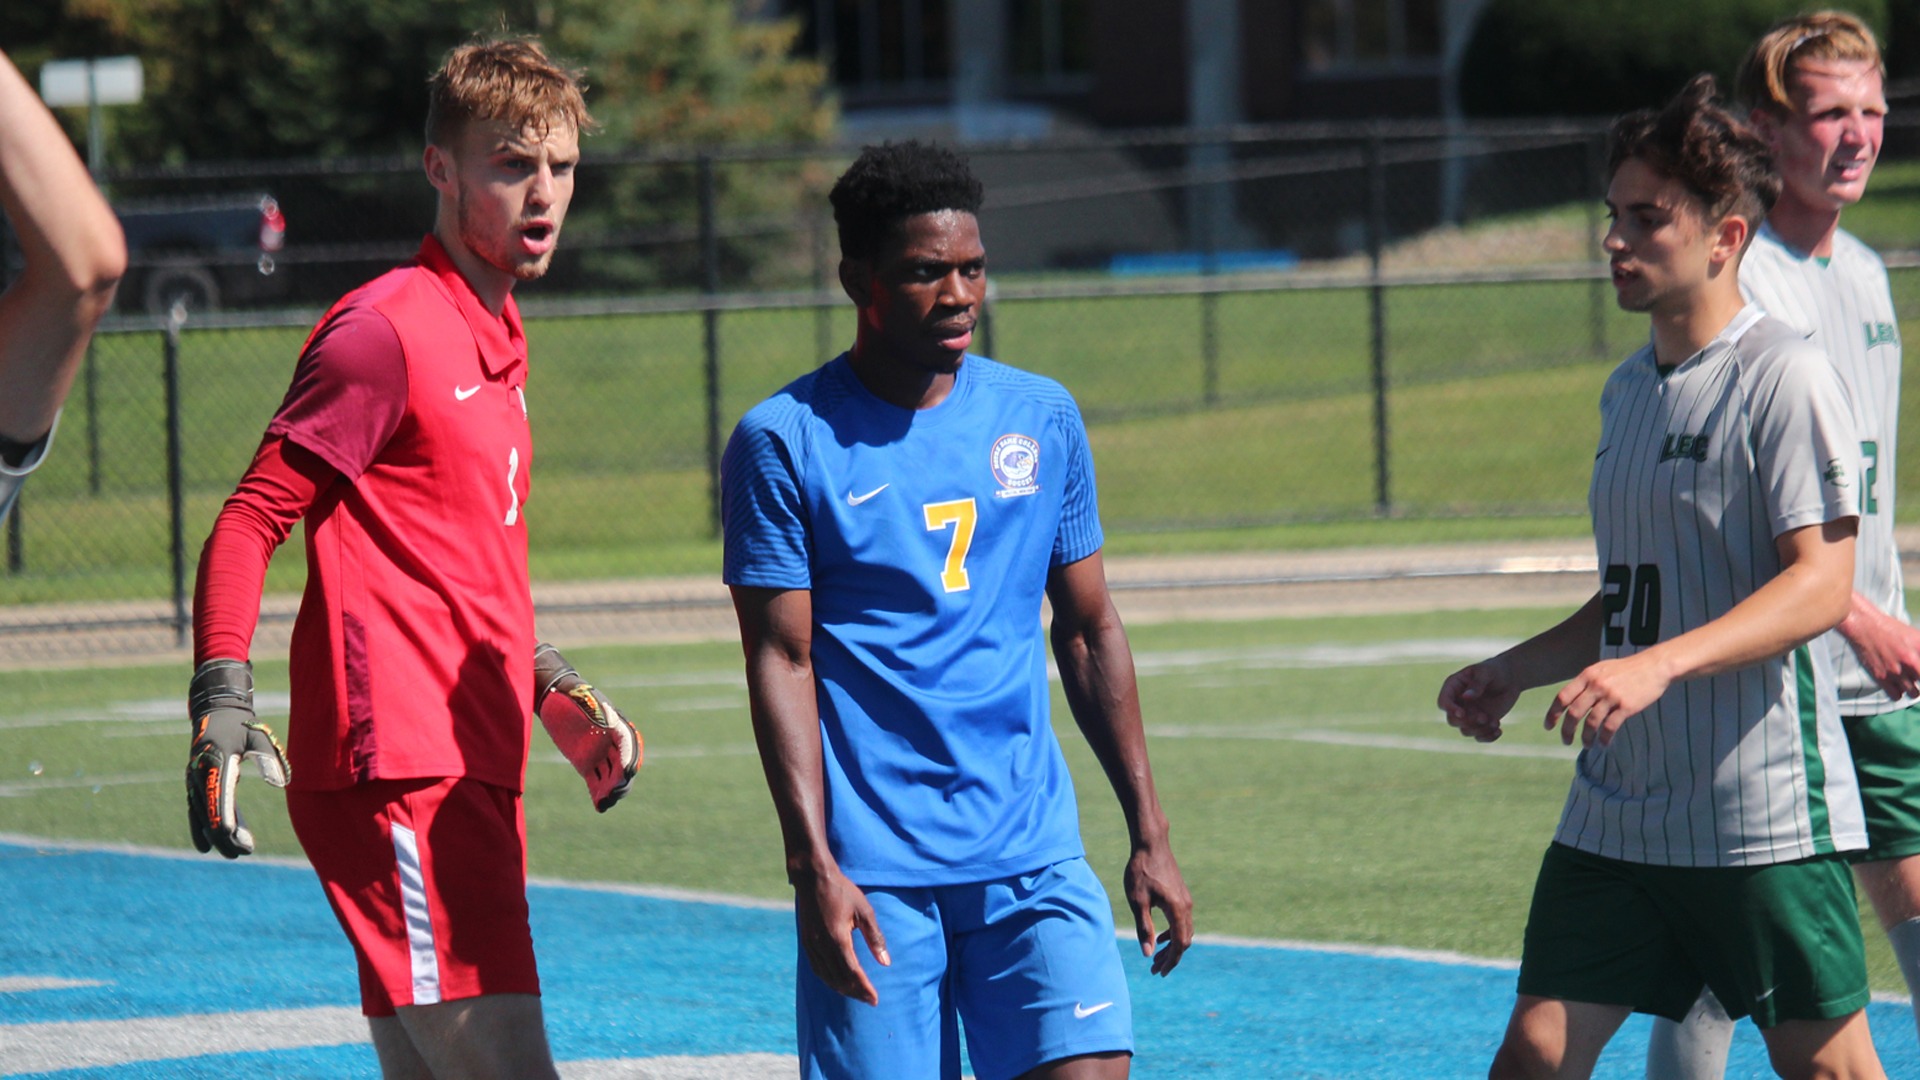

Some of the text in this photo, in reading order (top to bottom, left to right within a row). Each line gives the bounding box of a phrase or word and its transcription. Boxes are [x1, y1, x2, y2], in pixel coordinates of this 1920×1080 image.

[1660, 432, 1709, 464] LEC
[923, 497, 977, 593] 7
[1603, 564, 1661, 646] 20
